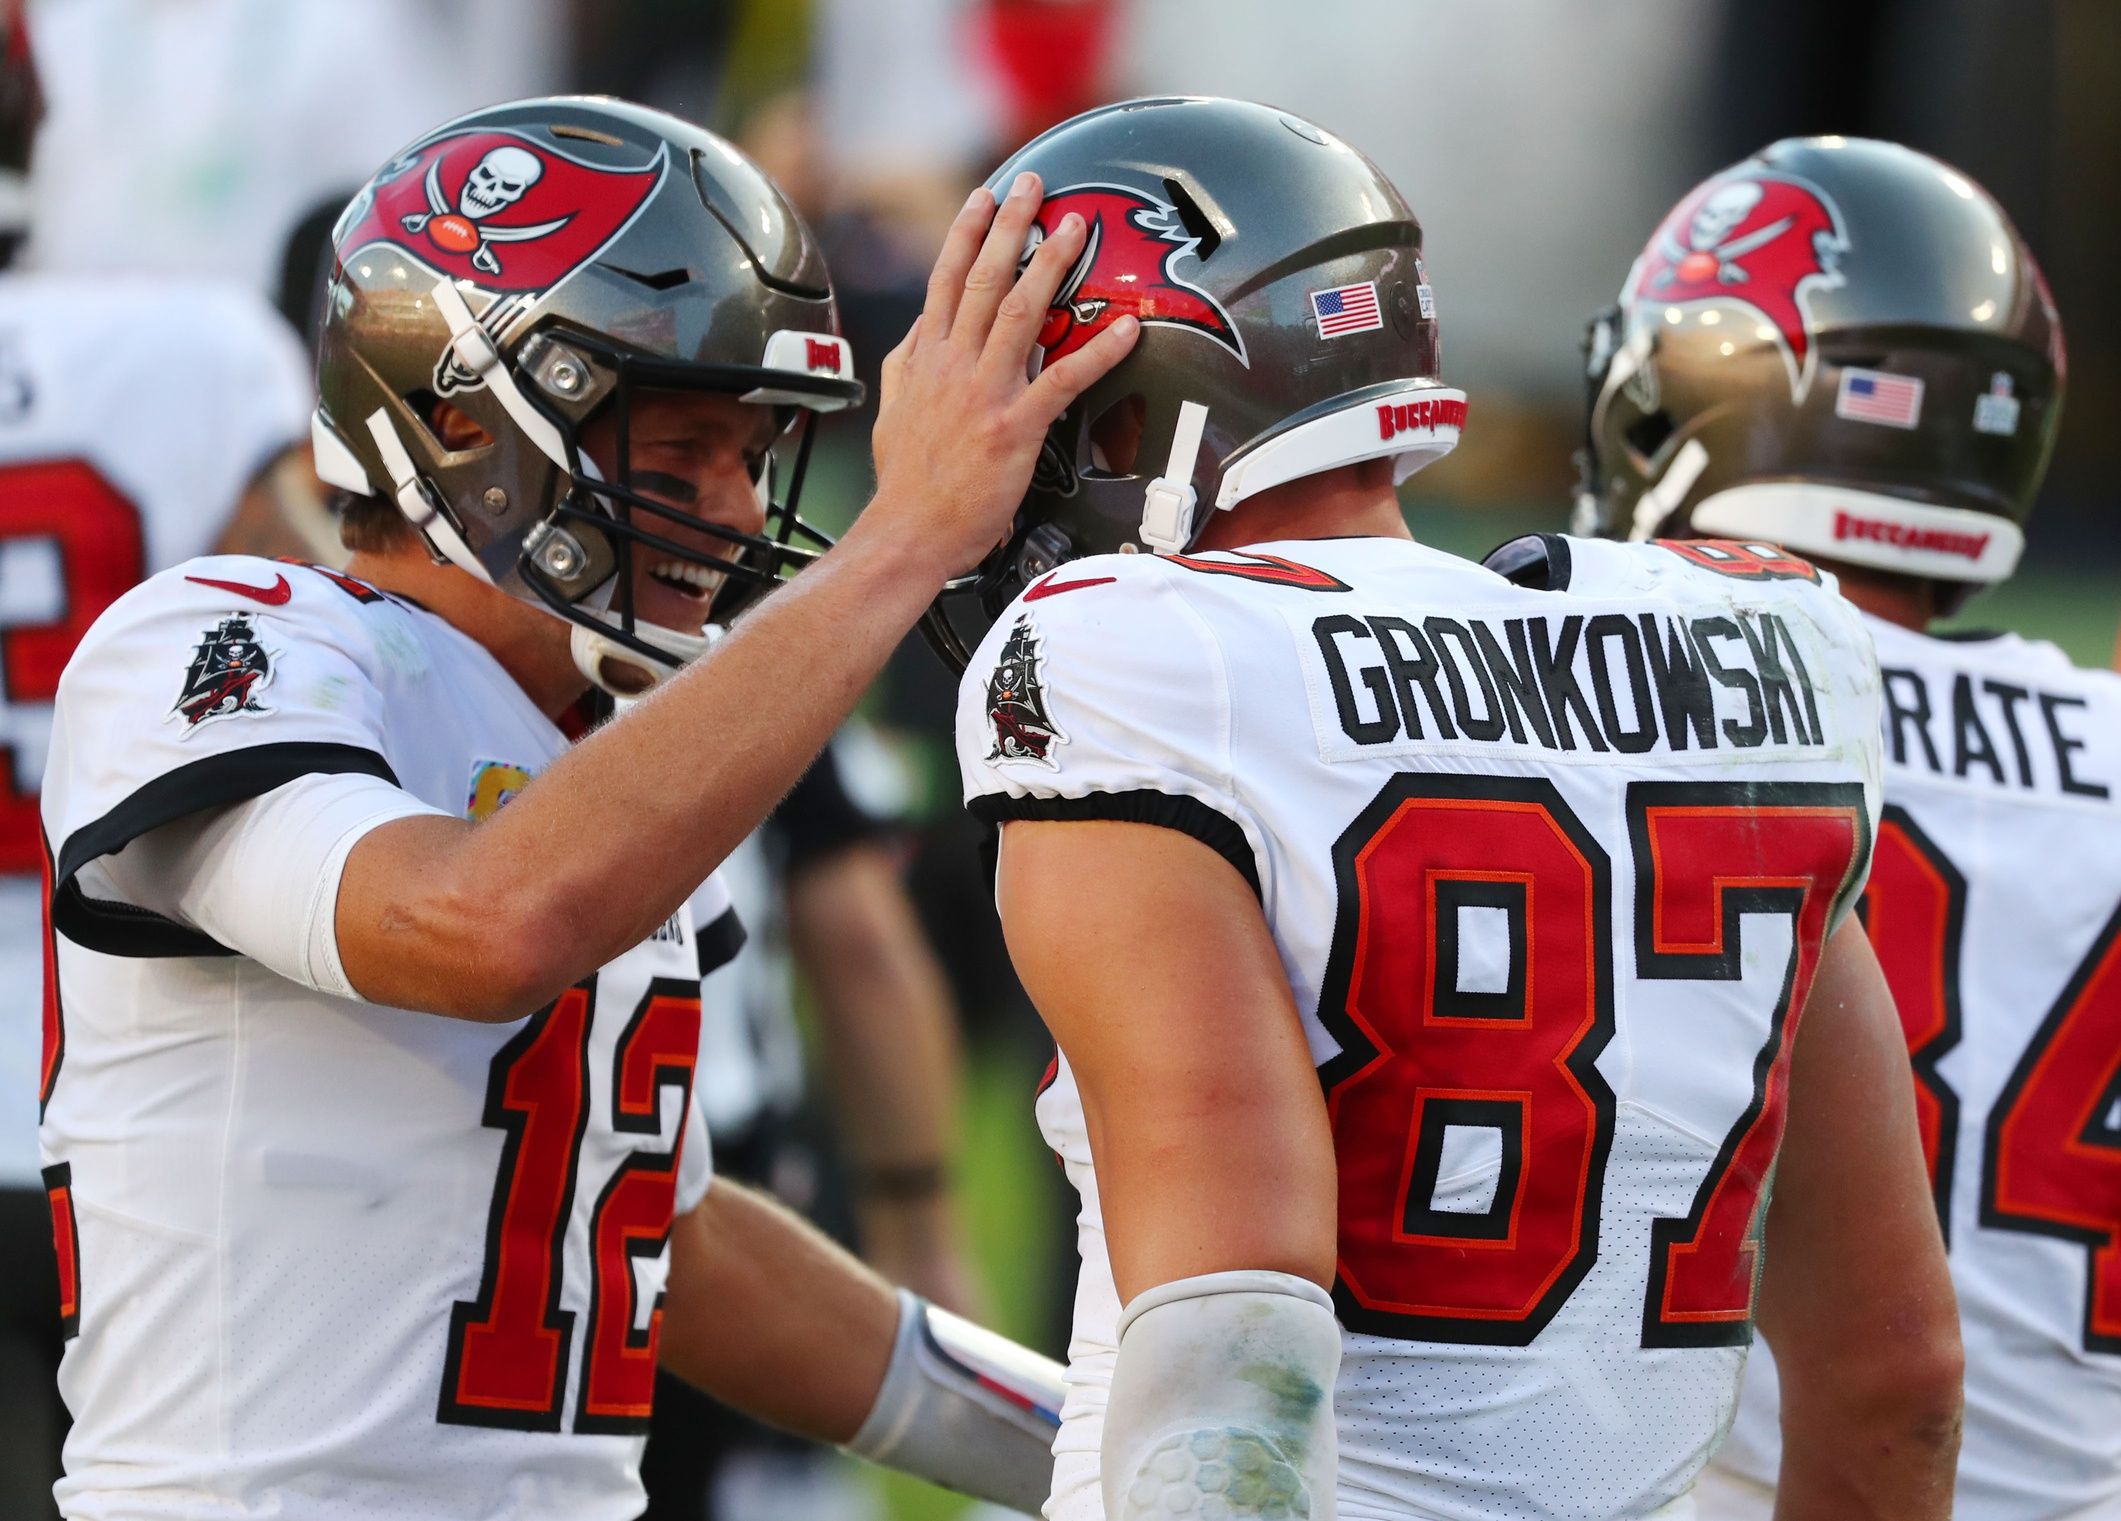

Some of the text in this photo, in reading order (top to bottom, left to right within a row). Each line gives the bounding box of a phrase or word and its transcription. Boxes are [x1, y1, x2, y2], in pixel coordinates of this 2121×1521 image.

[1312, 612, 1825, 754] GRONKOWSKI
[435, 970, 702, 1436] 12
[1315, 771, 1872, 1349] 87
